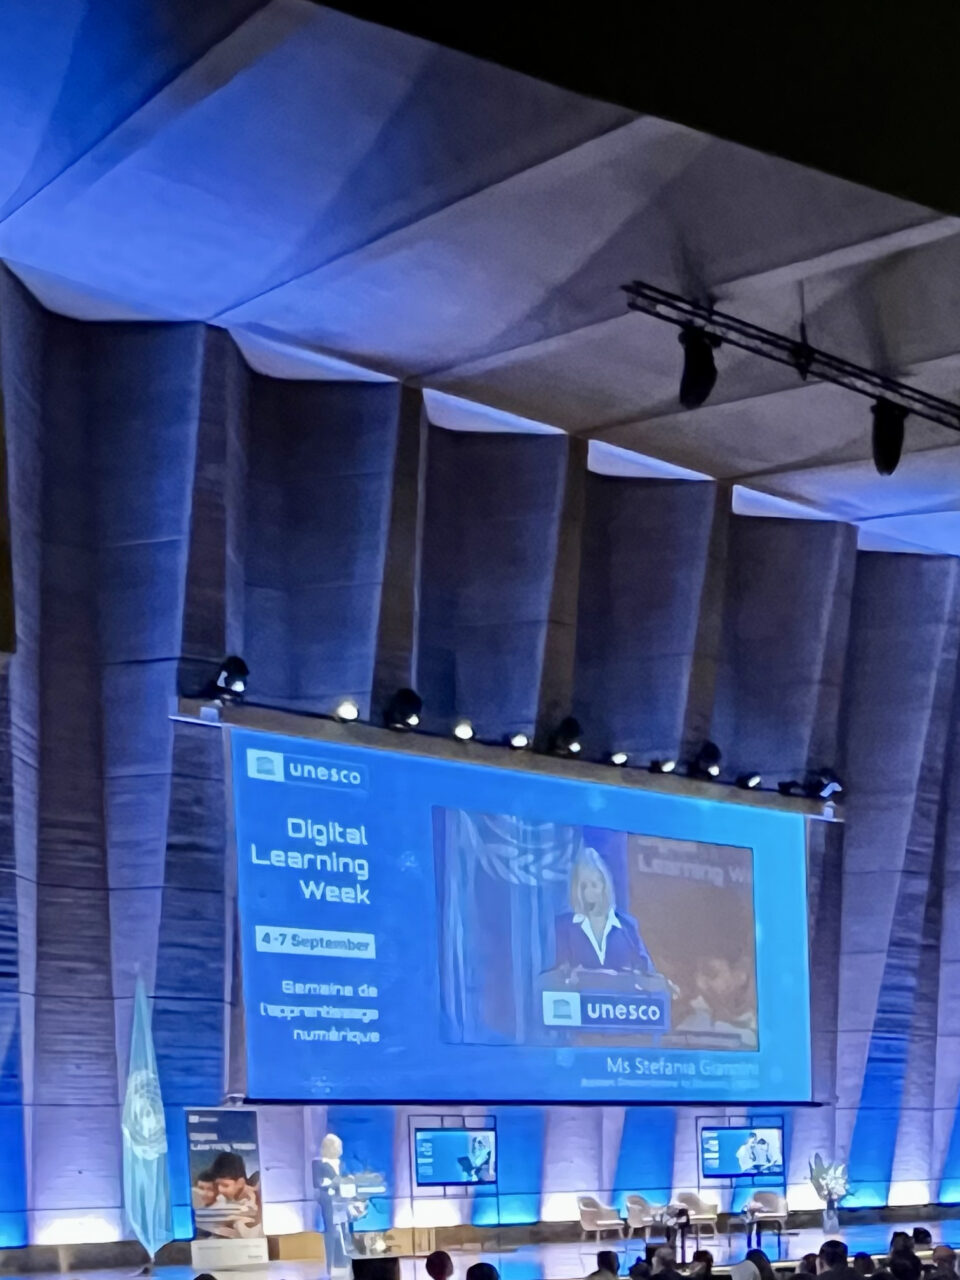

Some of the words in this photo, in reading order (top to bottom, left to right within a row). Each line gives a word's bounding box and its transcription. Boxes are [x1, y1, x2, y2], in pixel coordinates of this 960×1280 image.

[289, 762, 361, 785] unesco
[287, 817, 368, 846] Digital
[250, 843, 369, 881] Learning
[299, 879, 371, 905] Week
[290, 933, 371, 951] September
[281, 979, 354, 997] Semaine
[586, 999, 661, 1022] unesco
[606, 1056, 632, 1075] Ms
